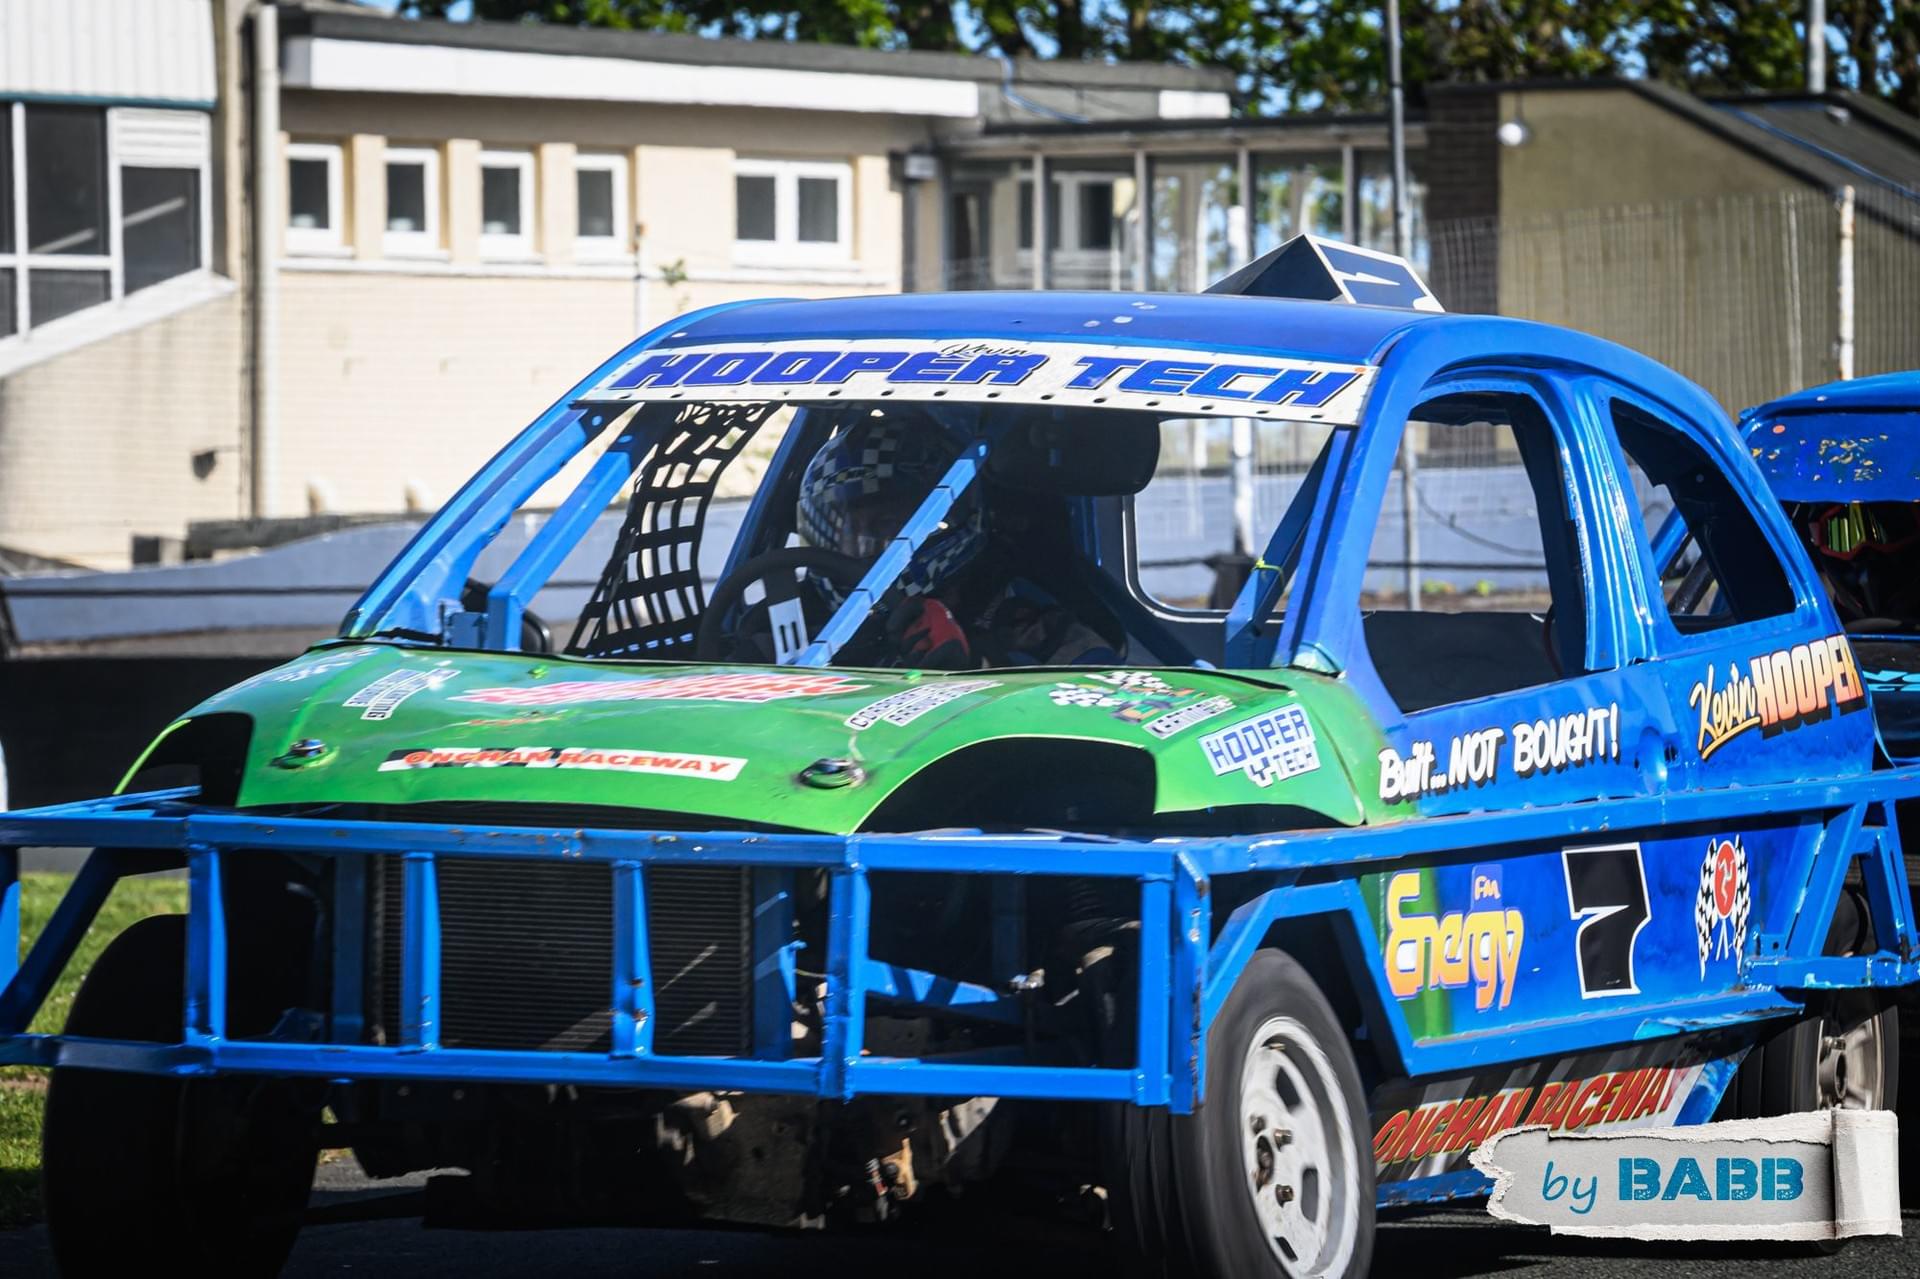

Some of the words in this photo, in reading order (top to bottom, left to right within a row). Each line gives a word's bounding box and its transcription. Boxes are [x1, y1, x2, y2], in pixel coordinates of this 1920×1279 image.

[608, 351, 1049, 389] HOOPER
[1063, 356, 1364, 407] TECH
[1689, 663, 1759, 757] Kevin
[1750, 634, 1865, 730] HOOPER
[404, 751, 554, 765] ONCHAN
[556, 752, 731, 773] RACEWAY
[1205, 709, 1310, 769] HOOPER
[1512, 702, 1620, 773] BOUGHT!
[1475, 875, 1501, 900] FM
[1385, 871, 1525, 1011] Energy
[1562, 842, 1651, 1000] 7
[1527, 1065, 1688, 1131] RACEWAY
